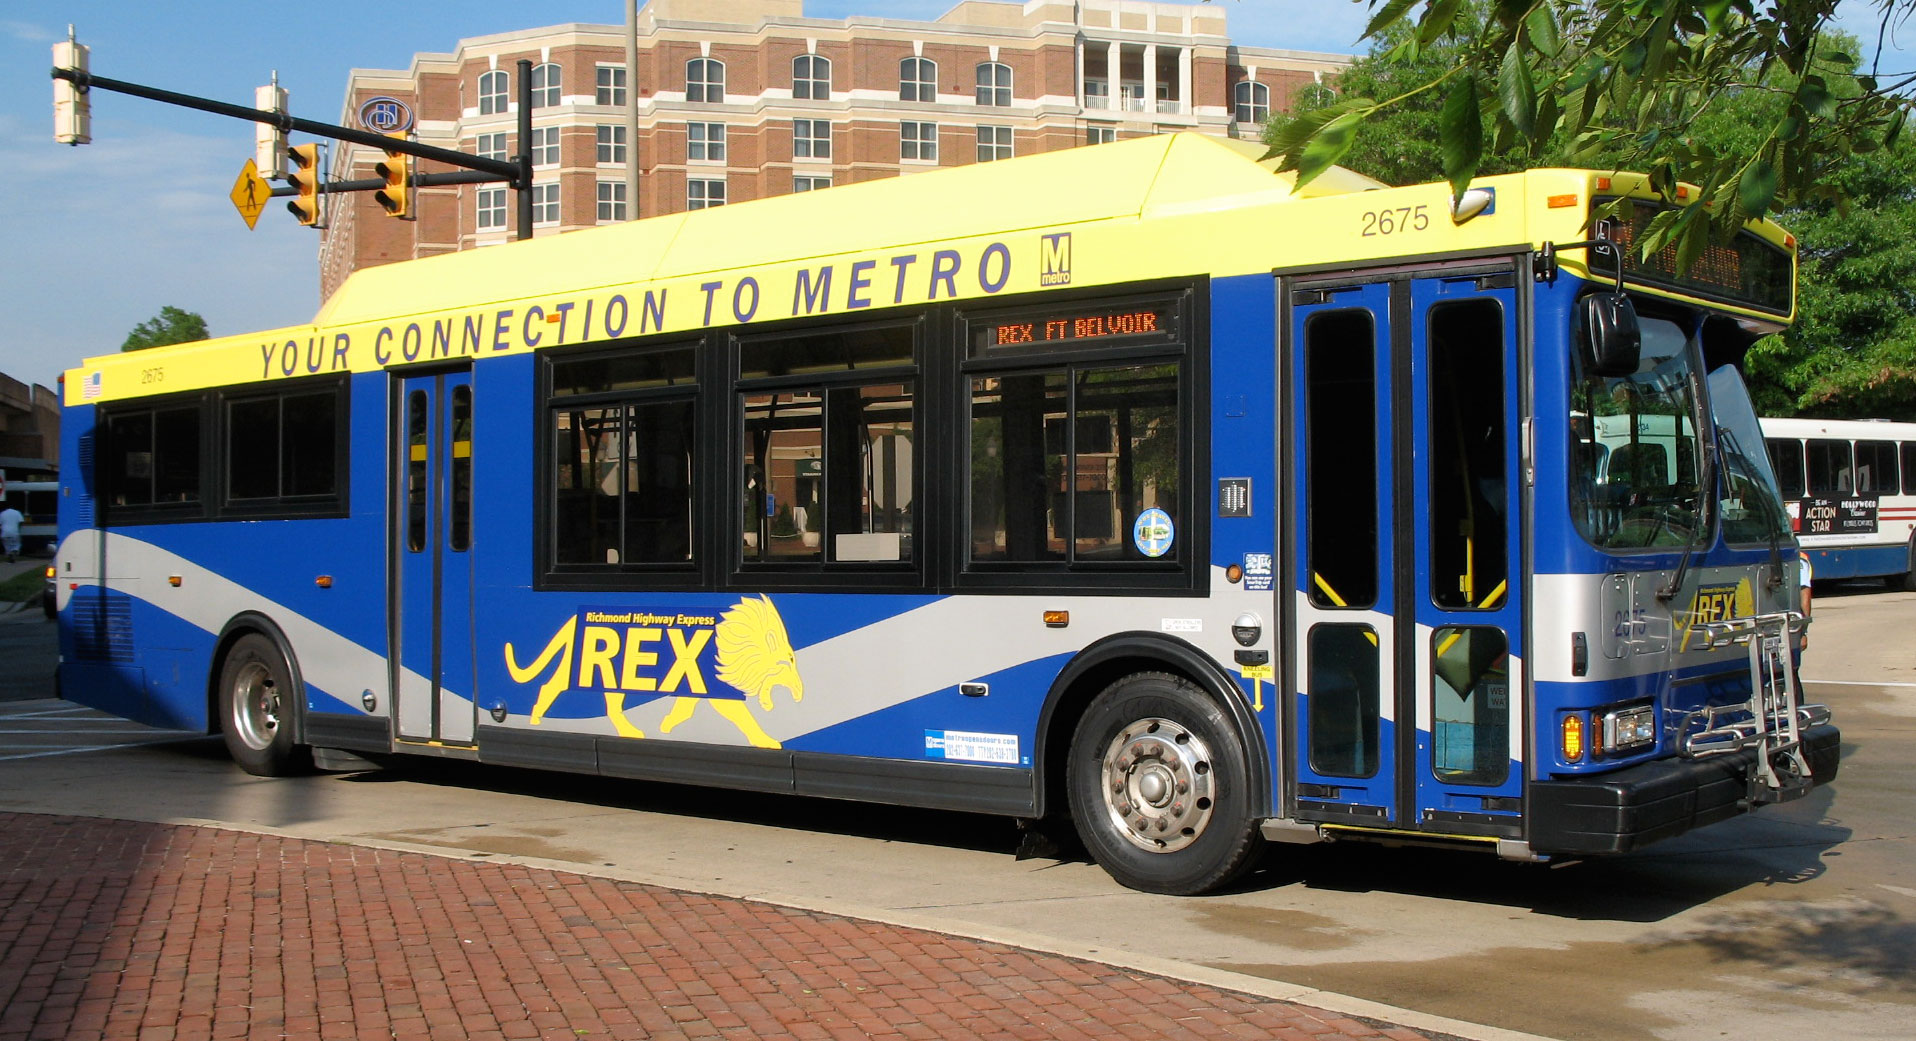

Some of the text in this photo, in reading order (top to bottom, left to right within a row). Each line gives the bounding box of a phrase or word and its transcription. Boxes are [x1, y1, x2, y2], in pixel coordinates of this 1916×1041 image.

[1361, 205, 1429, 237] 2675
[1042, 270, 1070, 285] metro
[261, 242, 1012, 379] YOUR CONNECTION TO METRO
[998, 312, 1157, 345] REX FT BELVOIR
[141, 366, 164, 385] 2675
[1805, 506, 1836, 519] ACTION
[1841, 500, 1877, 509] HOLLYWOOD
[1811, 520, 1830, 532] STAR
[586, 612, 715, 628] Richmond Highway Express
[1698, 593, 1736, 624] REX
[1614, 609, 1647, 638] 2675
[578, 626, 715, 694] REX
